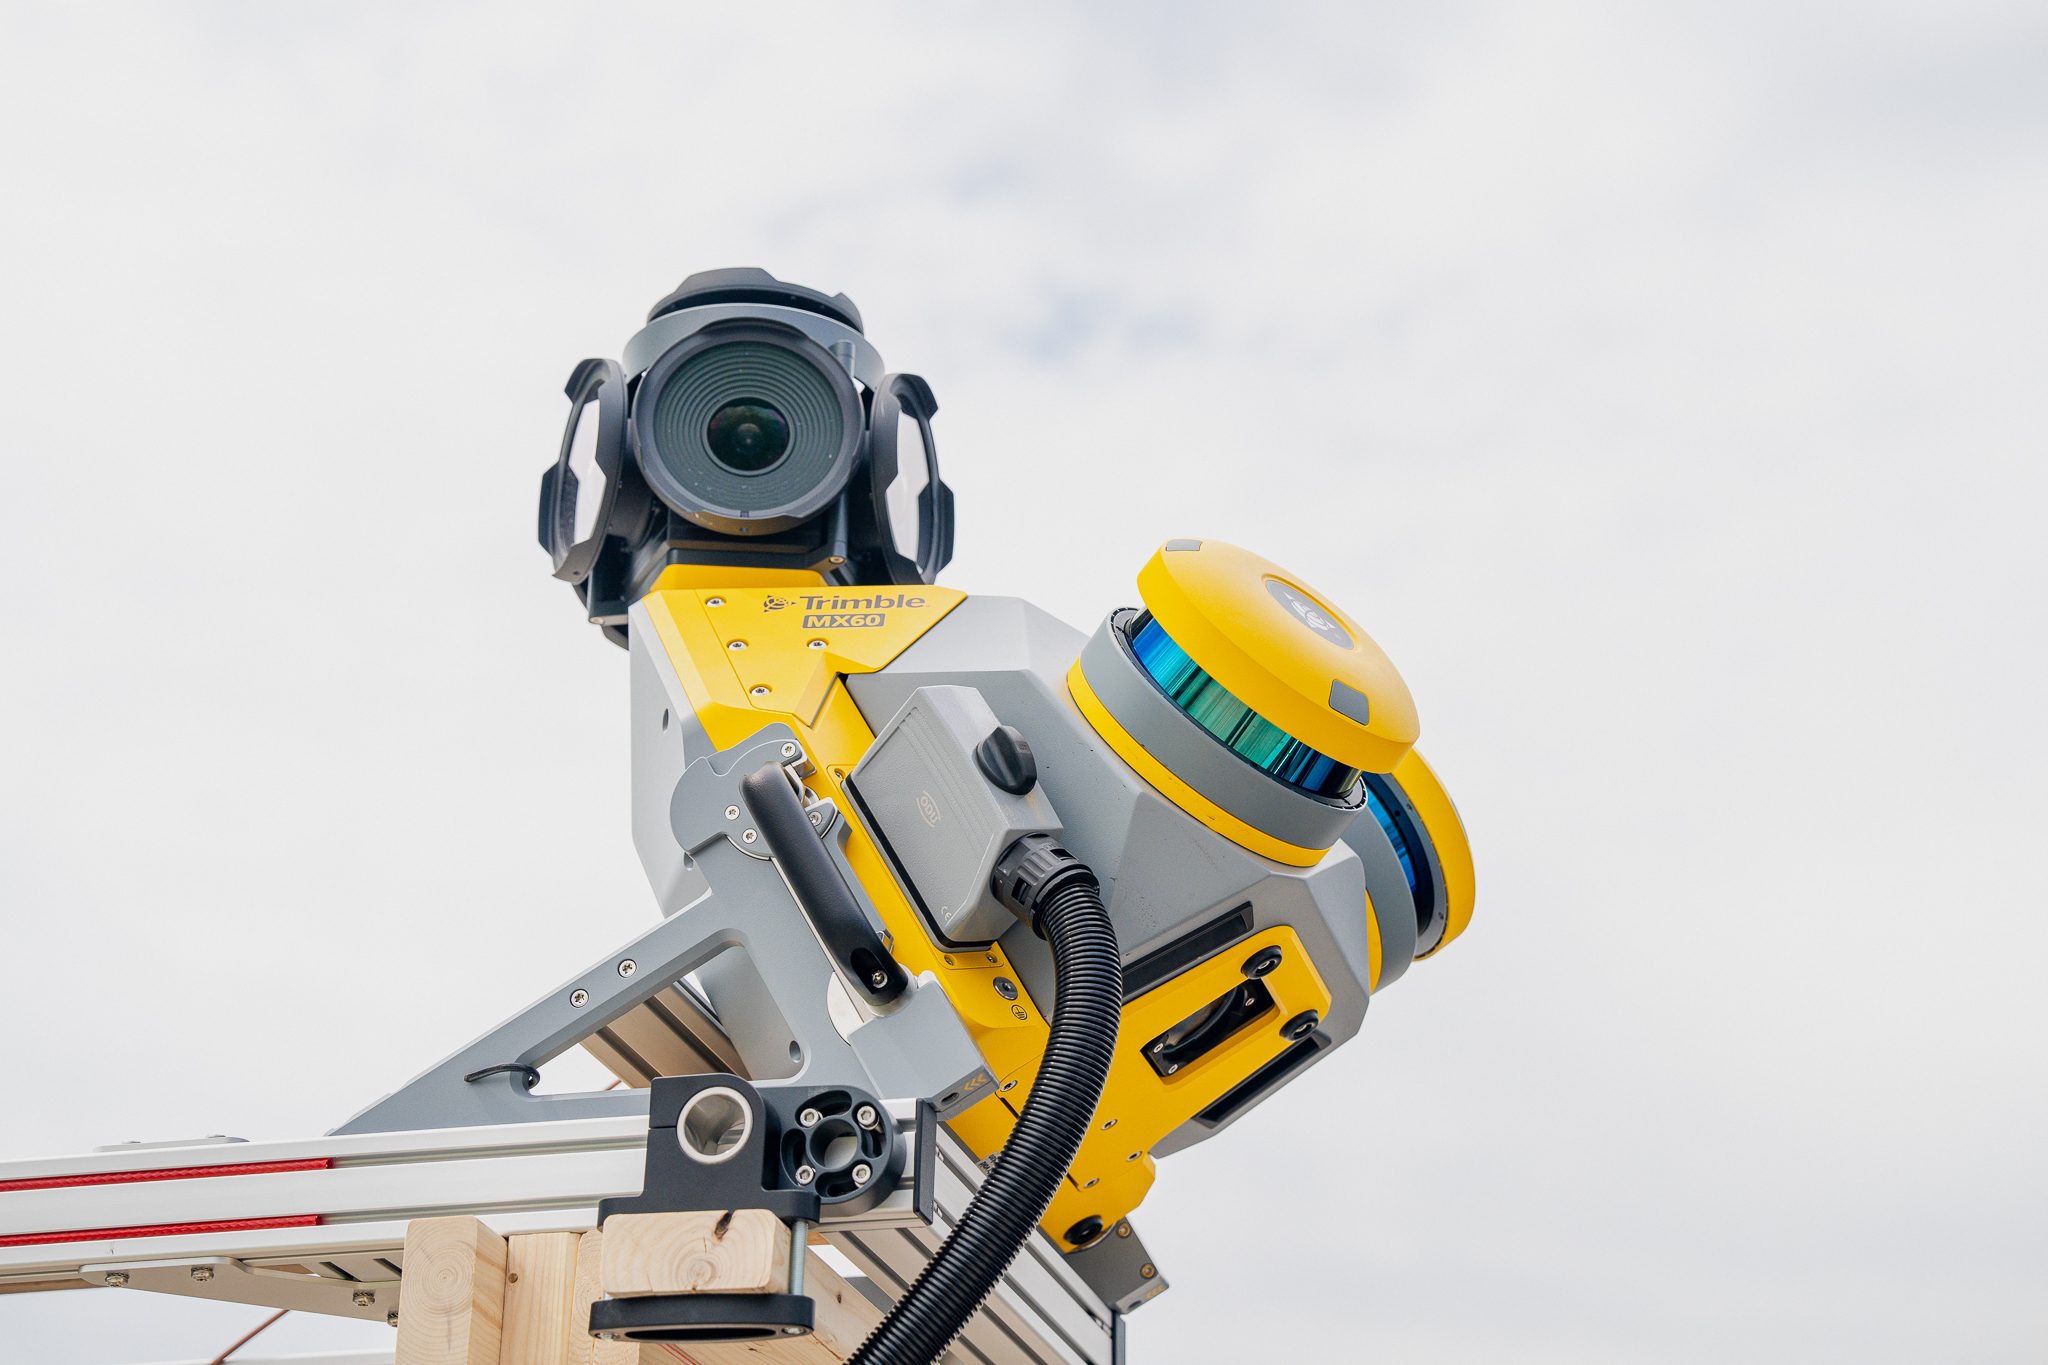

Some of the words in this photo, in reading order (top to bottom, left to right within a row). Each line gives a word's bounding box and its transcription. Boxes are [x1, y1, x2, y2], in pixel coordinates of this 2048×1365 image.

[800, 595, 926, 610] Trimble
[806, 614, 881, 627] MX60
[920, 795, 939, 824] ODU
